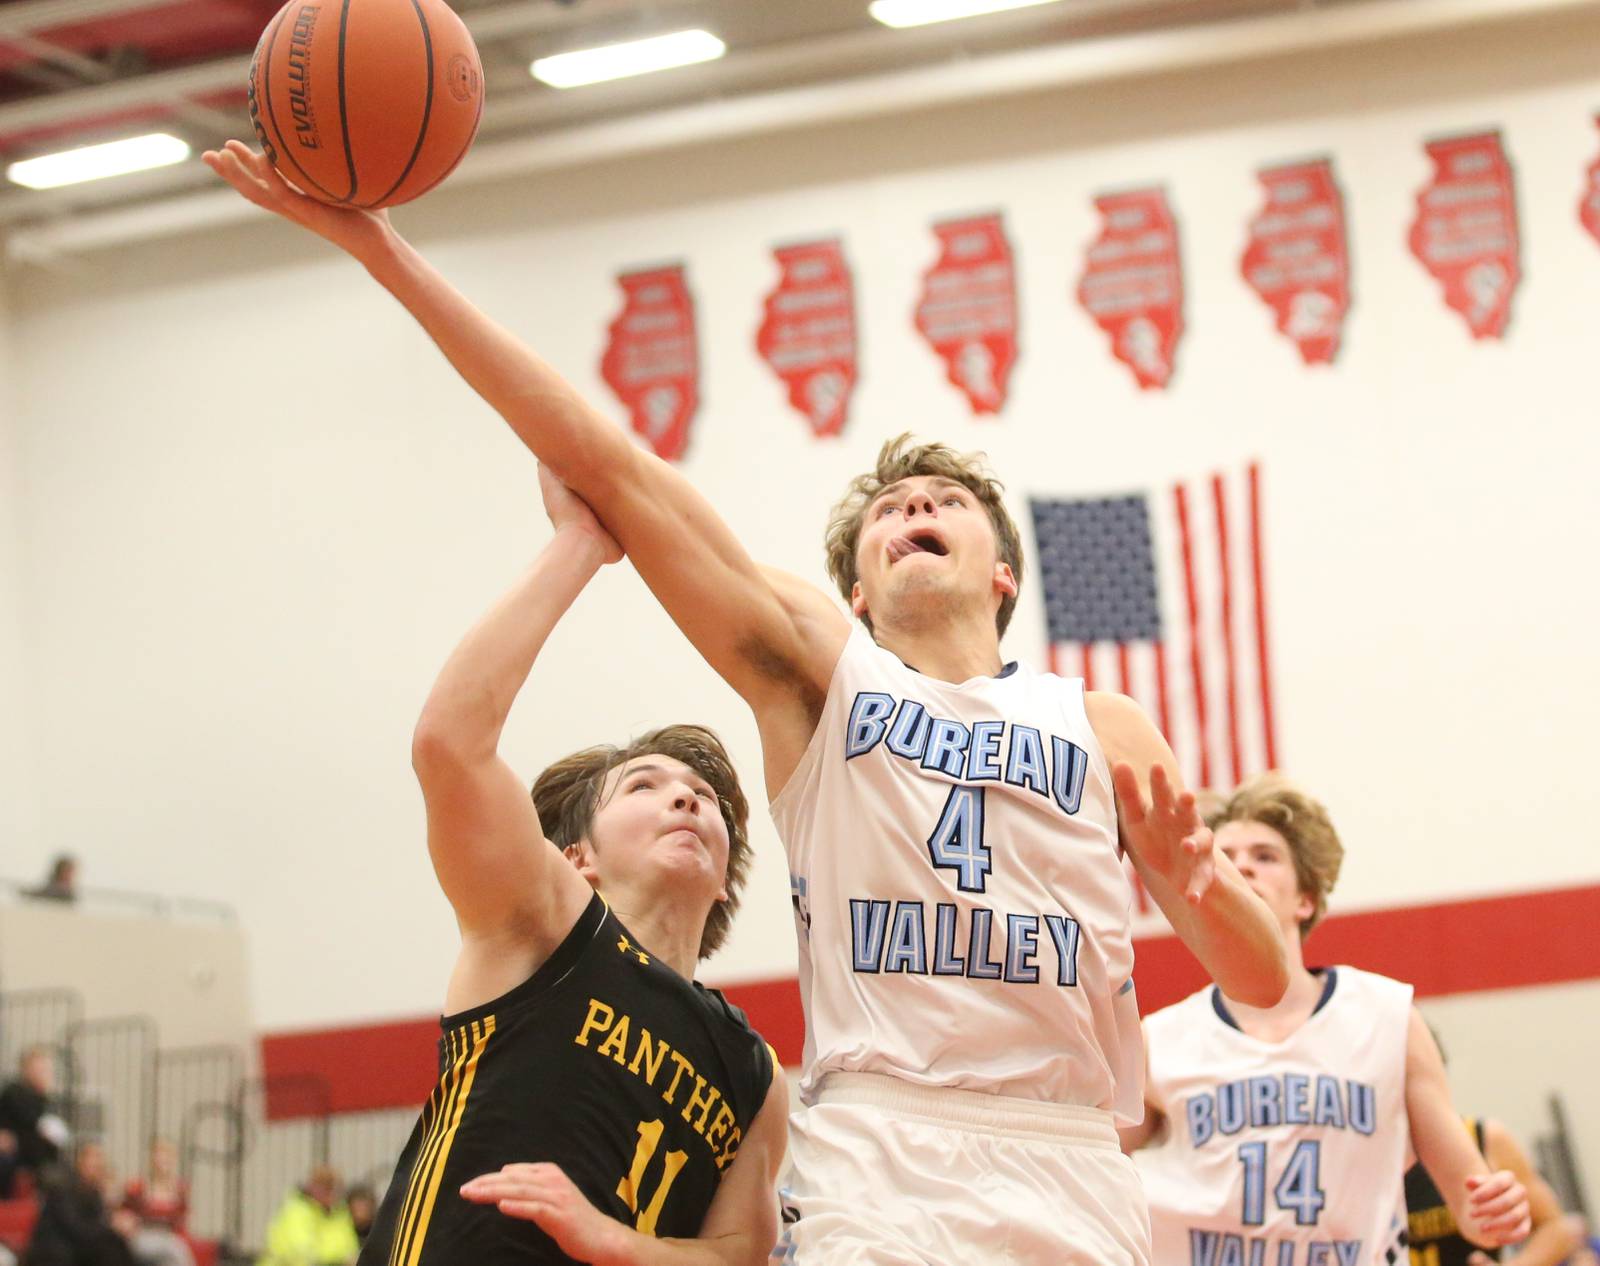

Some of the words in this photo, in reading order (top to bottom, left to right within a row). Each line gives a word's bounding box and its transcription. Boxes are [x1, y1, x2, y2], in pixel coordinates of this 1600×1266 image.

[288, 5, 320, 150] EVOLUTION
[846, 692, 1088, 815] BUREAU
[927, 785, 992, 893] 4
[849, 899, 1080, 986] VALLEY
[1187, 1073, 1377, 1148] BUREAU
[616, 1118, 688, 1238] 11
[1239, 1140, 1325, 1226] 14
